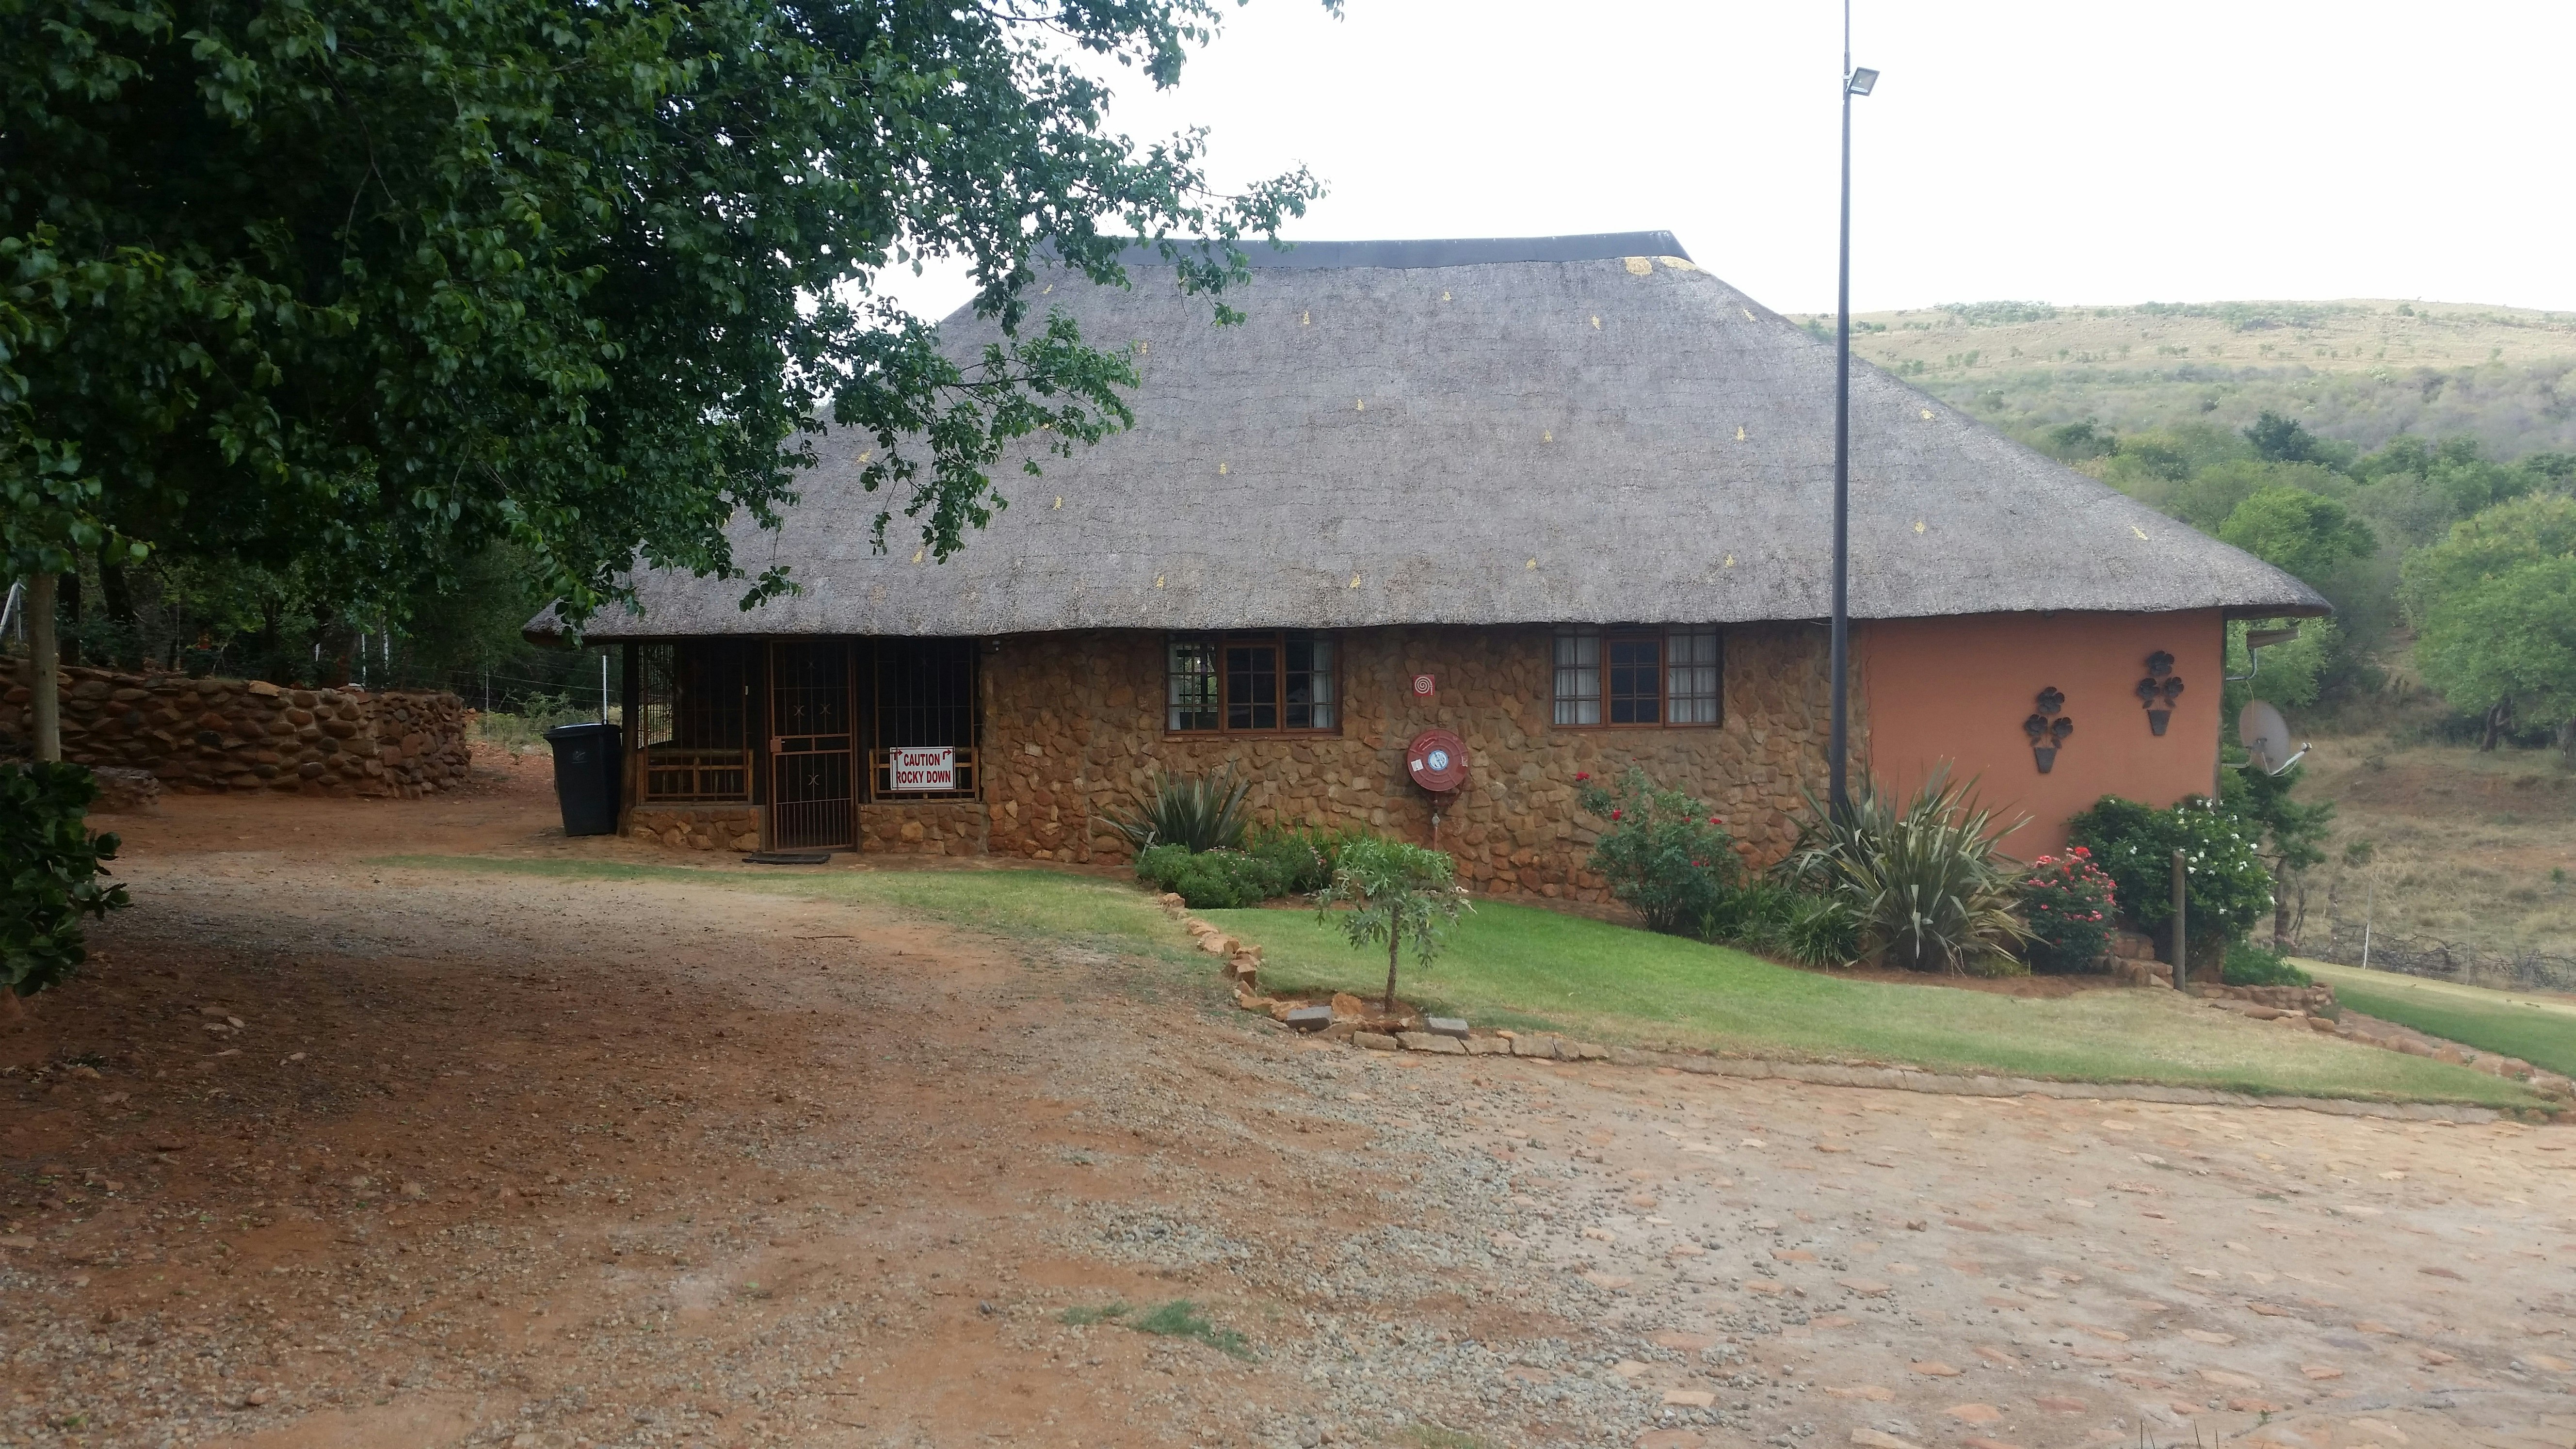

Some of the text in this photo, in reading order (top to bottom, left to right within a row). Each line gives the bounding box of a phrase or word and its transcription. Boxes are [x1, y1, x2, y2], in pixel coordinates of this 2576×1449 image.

[904, 753, 940, 766] CAUTION
[897, 770, 951, 784] ROCKY DOWN
